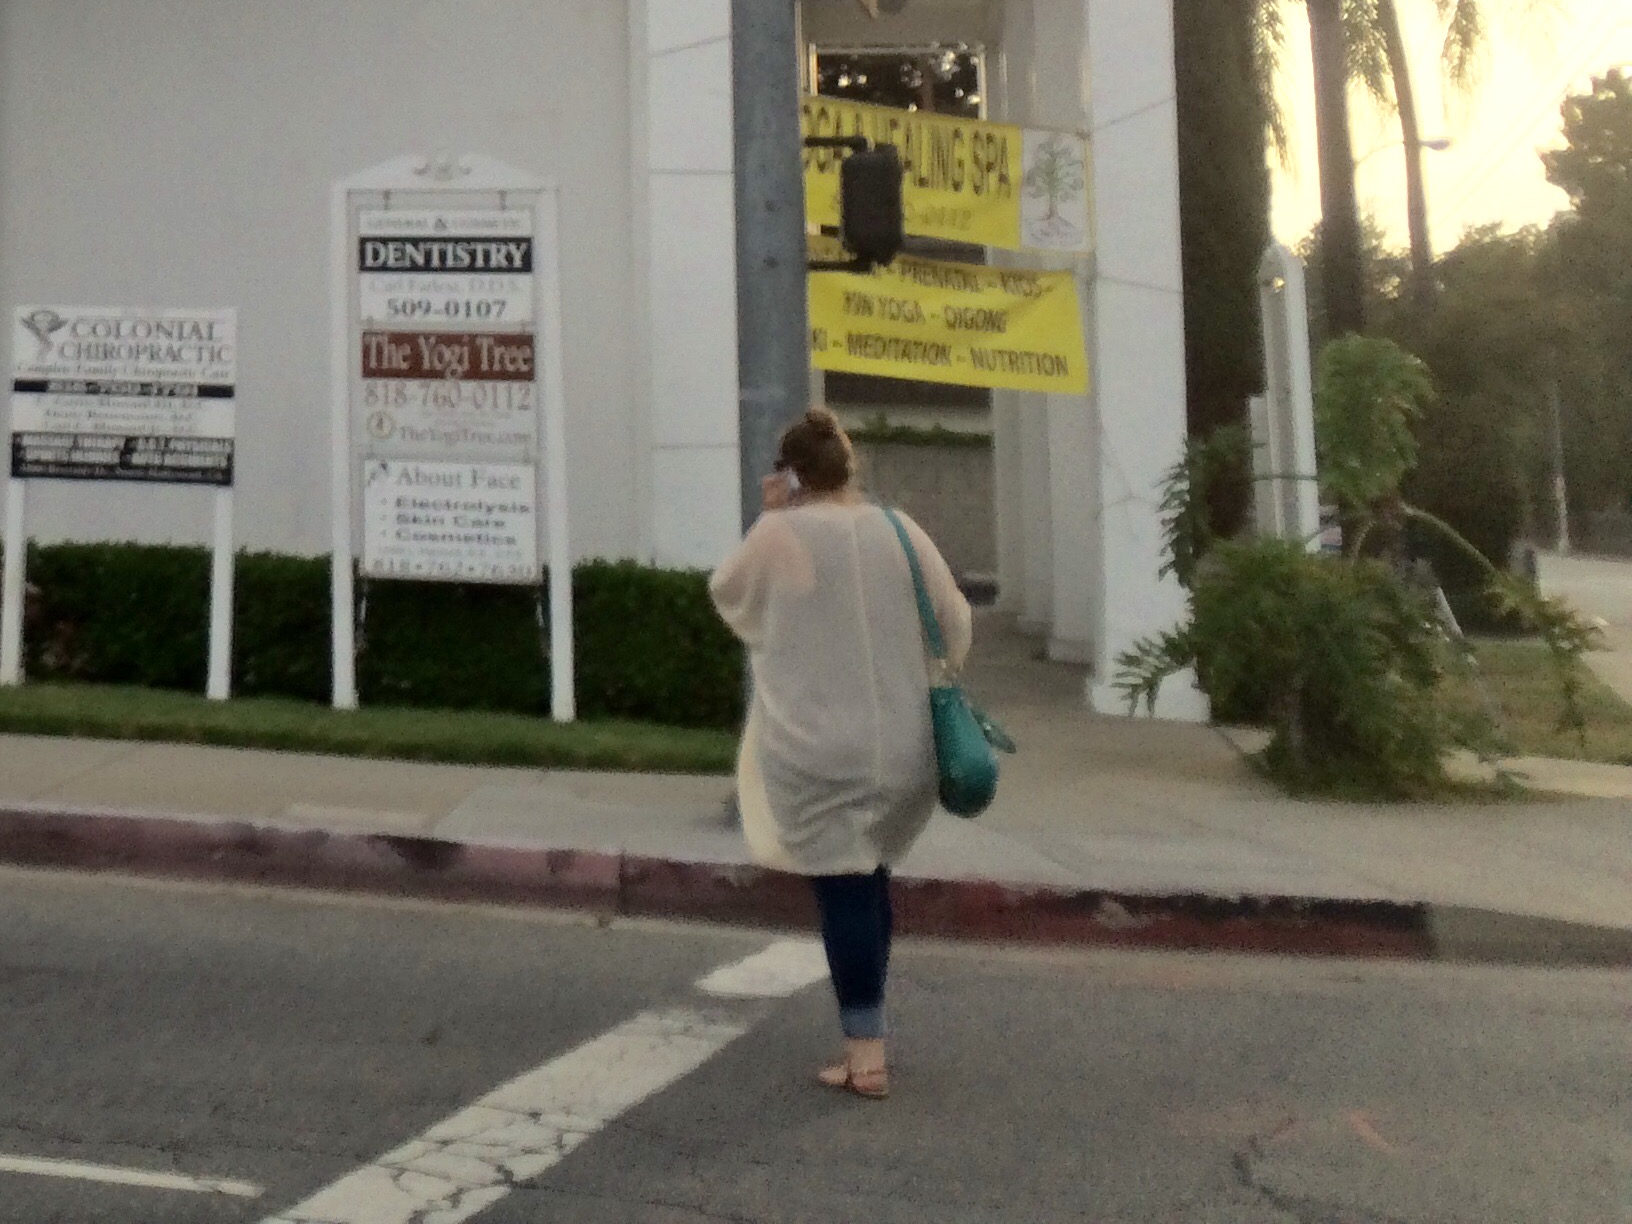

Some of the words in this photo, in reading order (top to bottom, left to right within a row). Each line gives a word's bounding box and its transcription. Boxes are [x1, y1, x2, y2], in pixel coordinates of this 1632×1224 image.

[972, 129, 1012, 198] SPA
[364, 241, 527, 268] DENTISTRY
[387, 298, 507, 318] 509-0107
[878, 297, 926, 324] YOGA
[71, 319, 222, 342] COLONIAL
[58, 341, 233, 364] CHIROPRACTIC
[365, 335, 411, 370] The
[418, 334, 470, 379] Yogi
[475, 335, 532, 372] Tree
[846, 332, 952, 367] MEDITATION
[969, 348, 1069, 376] NUTRITION
[396, 466, 462, 487] About
[470, 469, 520, 490] Face
[396, 513, 445, 526] Skin
[453, 515, 506, 528] Care
[395, 528, 516, 546] Cosmetics
